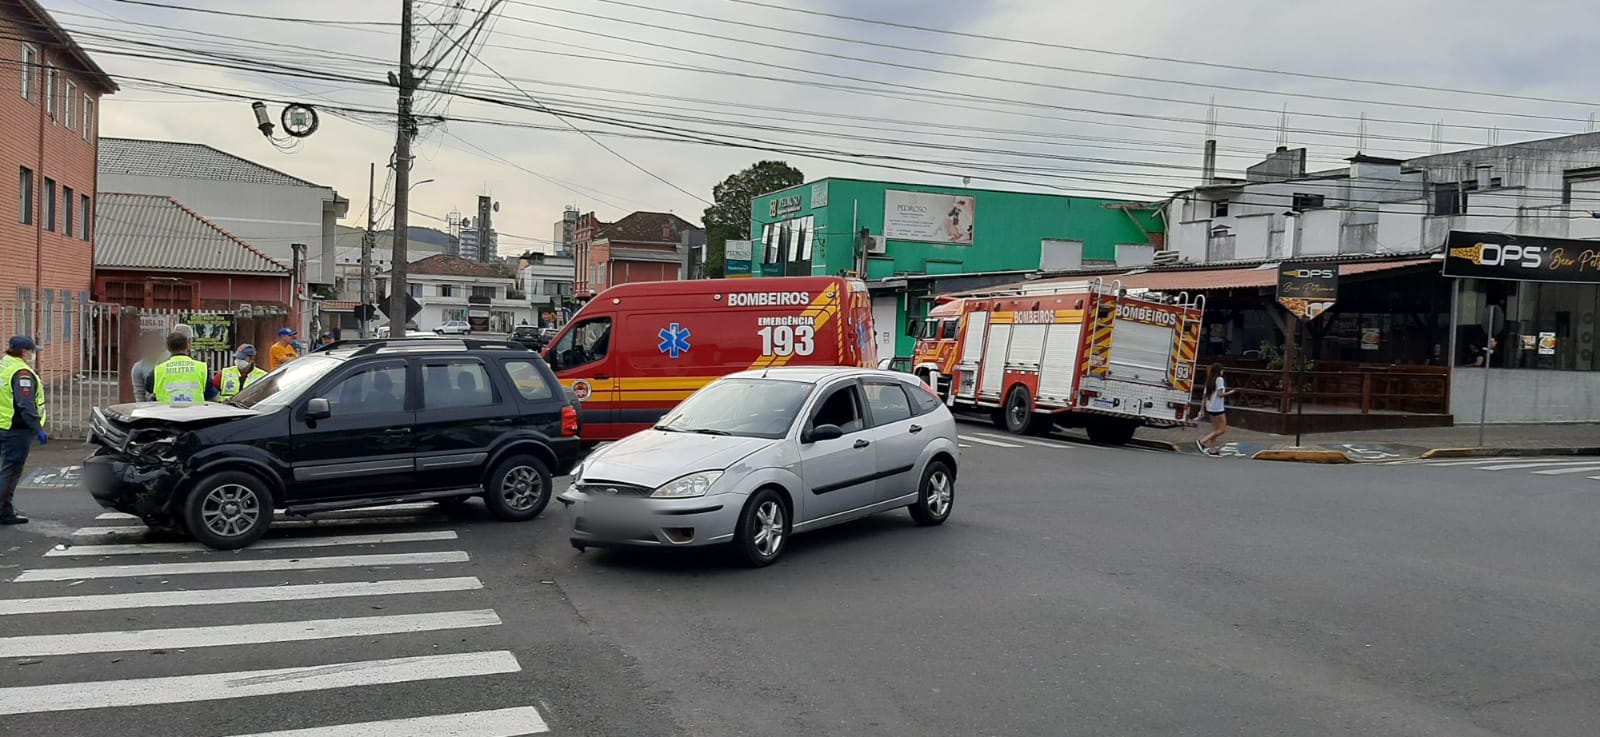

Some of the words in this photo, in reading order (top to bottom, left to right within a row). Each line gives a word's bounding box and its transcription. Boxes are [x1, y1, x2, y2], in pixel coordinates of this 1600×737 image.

[727, 291, 810, 307] BOMBEIROS
[757, 315, 815, 326] EMERGÊNCIA
[1013, 309, 1055, 324] BOMBEIROS
[1116, 304, 1177, 325] BOMBEIROS
[757, 325, 815, 356] 193
[166, 366, 195, 375] MILITAR
